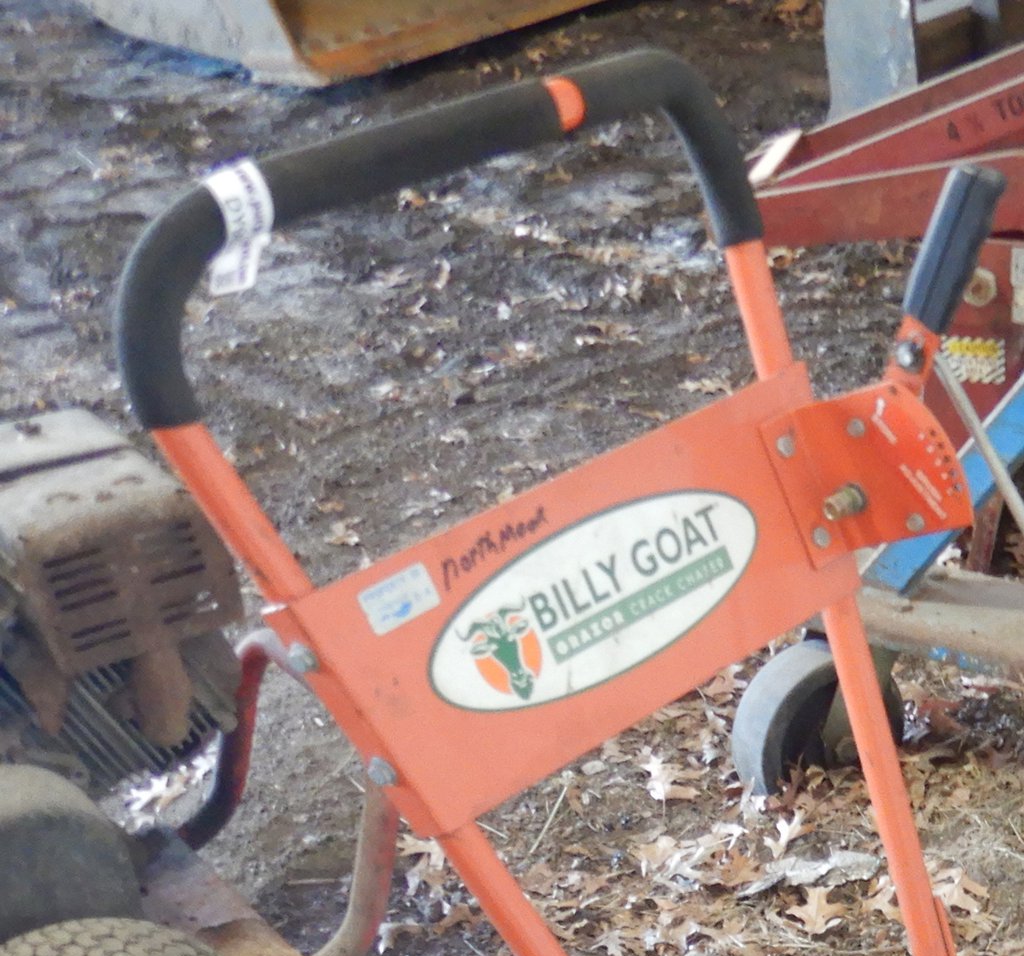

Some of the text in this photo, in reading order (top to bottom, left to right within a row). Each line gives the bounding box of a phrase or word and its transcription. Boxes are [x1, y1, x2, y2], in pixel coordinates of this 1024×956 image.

[529, 505, 719, 632] BILLY GOAT
[629, 583, 673, 617] CRACK
